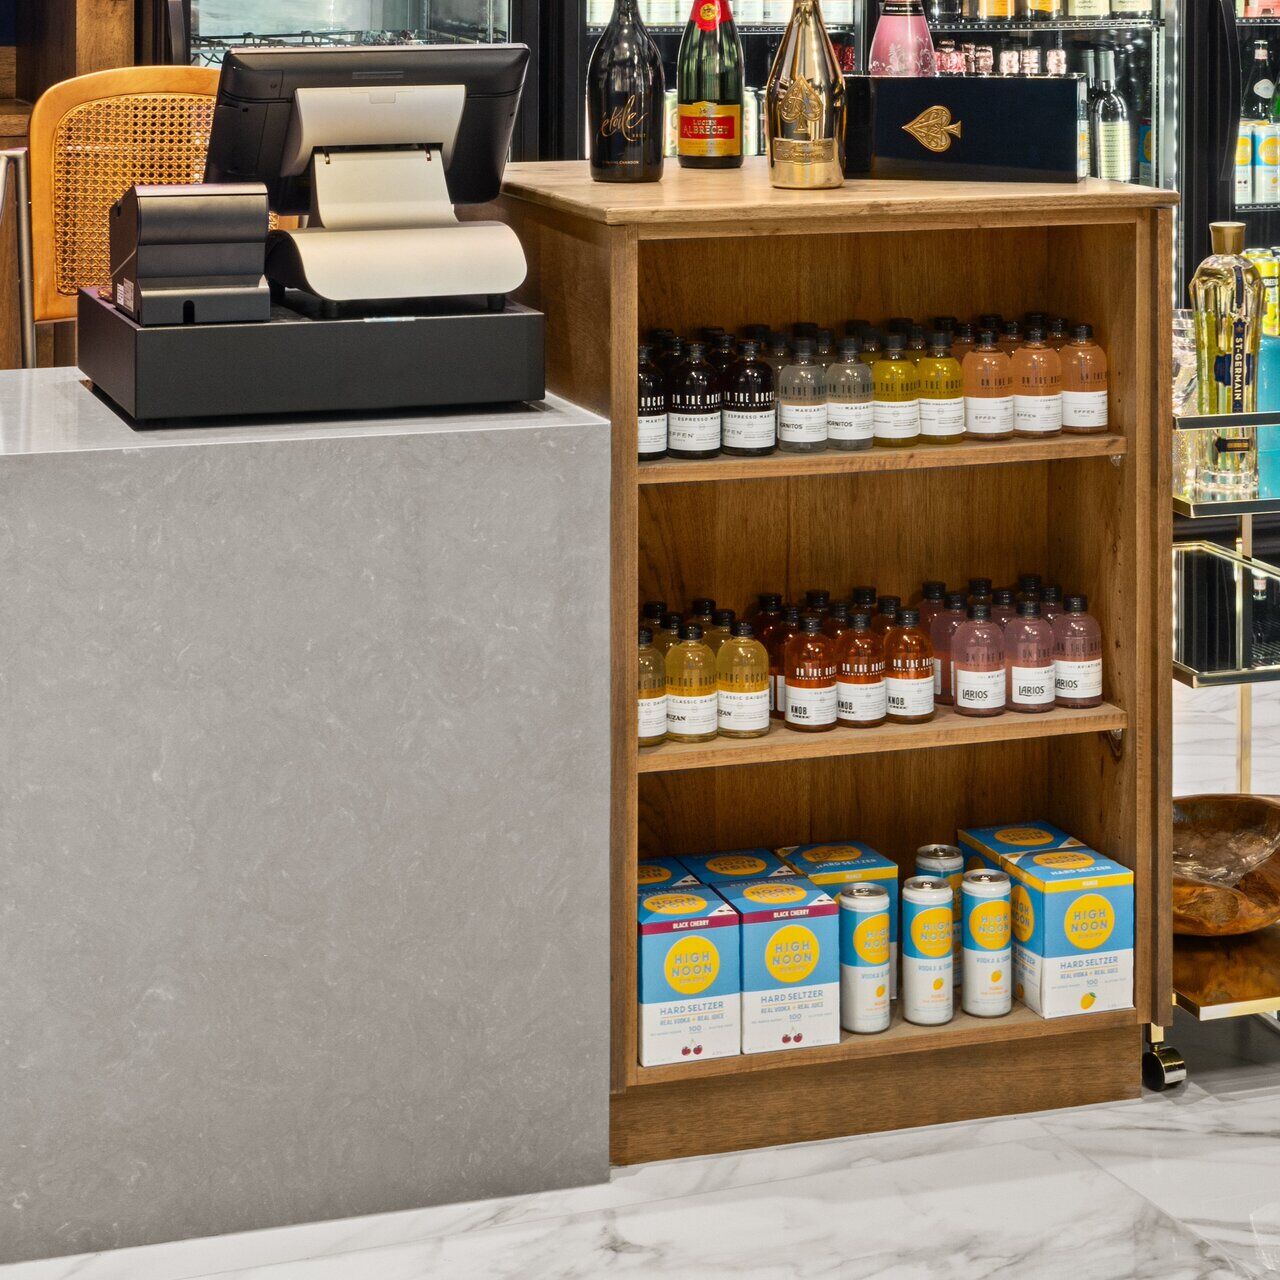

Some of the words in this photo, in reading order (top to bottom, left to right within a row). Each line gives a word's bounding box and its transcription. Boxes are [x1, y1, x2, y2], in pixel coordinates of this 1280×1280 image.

[683, 124, 729, 136] ALBRECHT
[1234, 336, 1242, 400] ST-GERMAIN
[641, 395, 665, 407] ROCKS
[686, 394, 701, 405] THE
[734, 392, 749, 402] THE
[962, 689, 988, 701] LARIOS
[1018, 685, 1045, 697] LARIOS
[837, 700, 853, 710] KNOB
[887, 696, 905, 706] KNOB
[790, 704, 808, 715] KNOB
[790, 909, 809, 917] CHERRY
[1074, 909, 1107, 920] HIGH
[690, 920, 710, 928] CHERRY
[1070, 920, 1108, 932] NOON
[775, 941, 811, 954] HIGH
[674, 951, 710, 964] HIGH
[772, 953, 813, 966] NOON
[1060, 960, 1084, 970] HARD
[1085, 956, 1119, 966] SELTZER
[671, 964, 713, 977] NOON
[760, 994, 786, 1004] HARD
[787, 990, 824, 1001] SELTZER
[659, 1006, 686, 1016] HARD
[687, 1001, 724, 1014] SELTZER
[788, 1013, 802, 1021] 100
